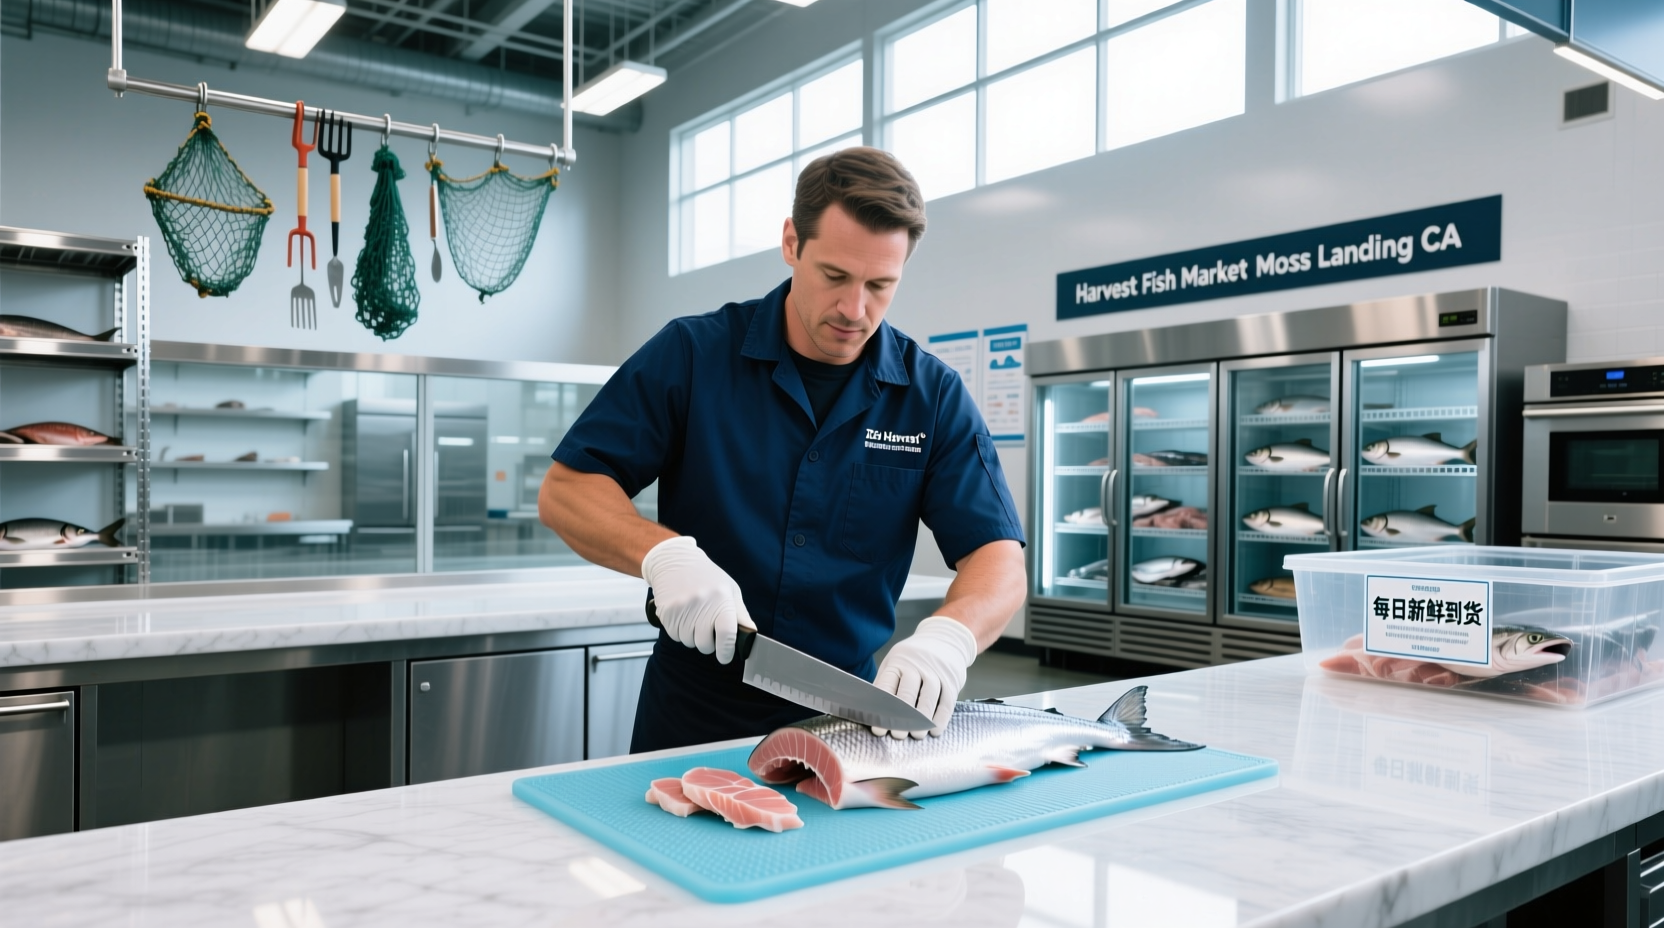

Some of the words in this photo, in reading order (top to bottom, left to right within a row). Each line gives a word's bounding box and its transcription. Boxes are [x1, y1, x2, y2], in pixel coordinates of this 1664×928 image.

[1075, 275, 1138, 304] Harvest
[1141, 269, 1176, 296] Fish
[1181, 259, 1248, 289] Market
[1255, 251, 1311, 278] Moss
[1317, 234, 1414, 269] Landing
[1420, 223, 1462, 253] CA
[1373, 596, 1483, 626] 每日新鲜到货
